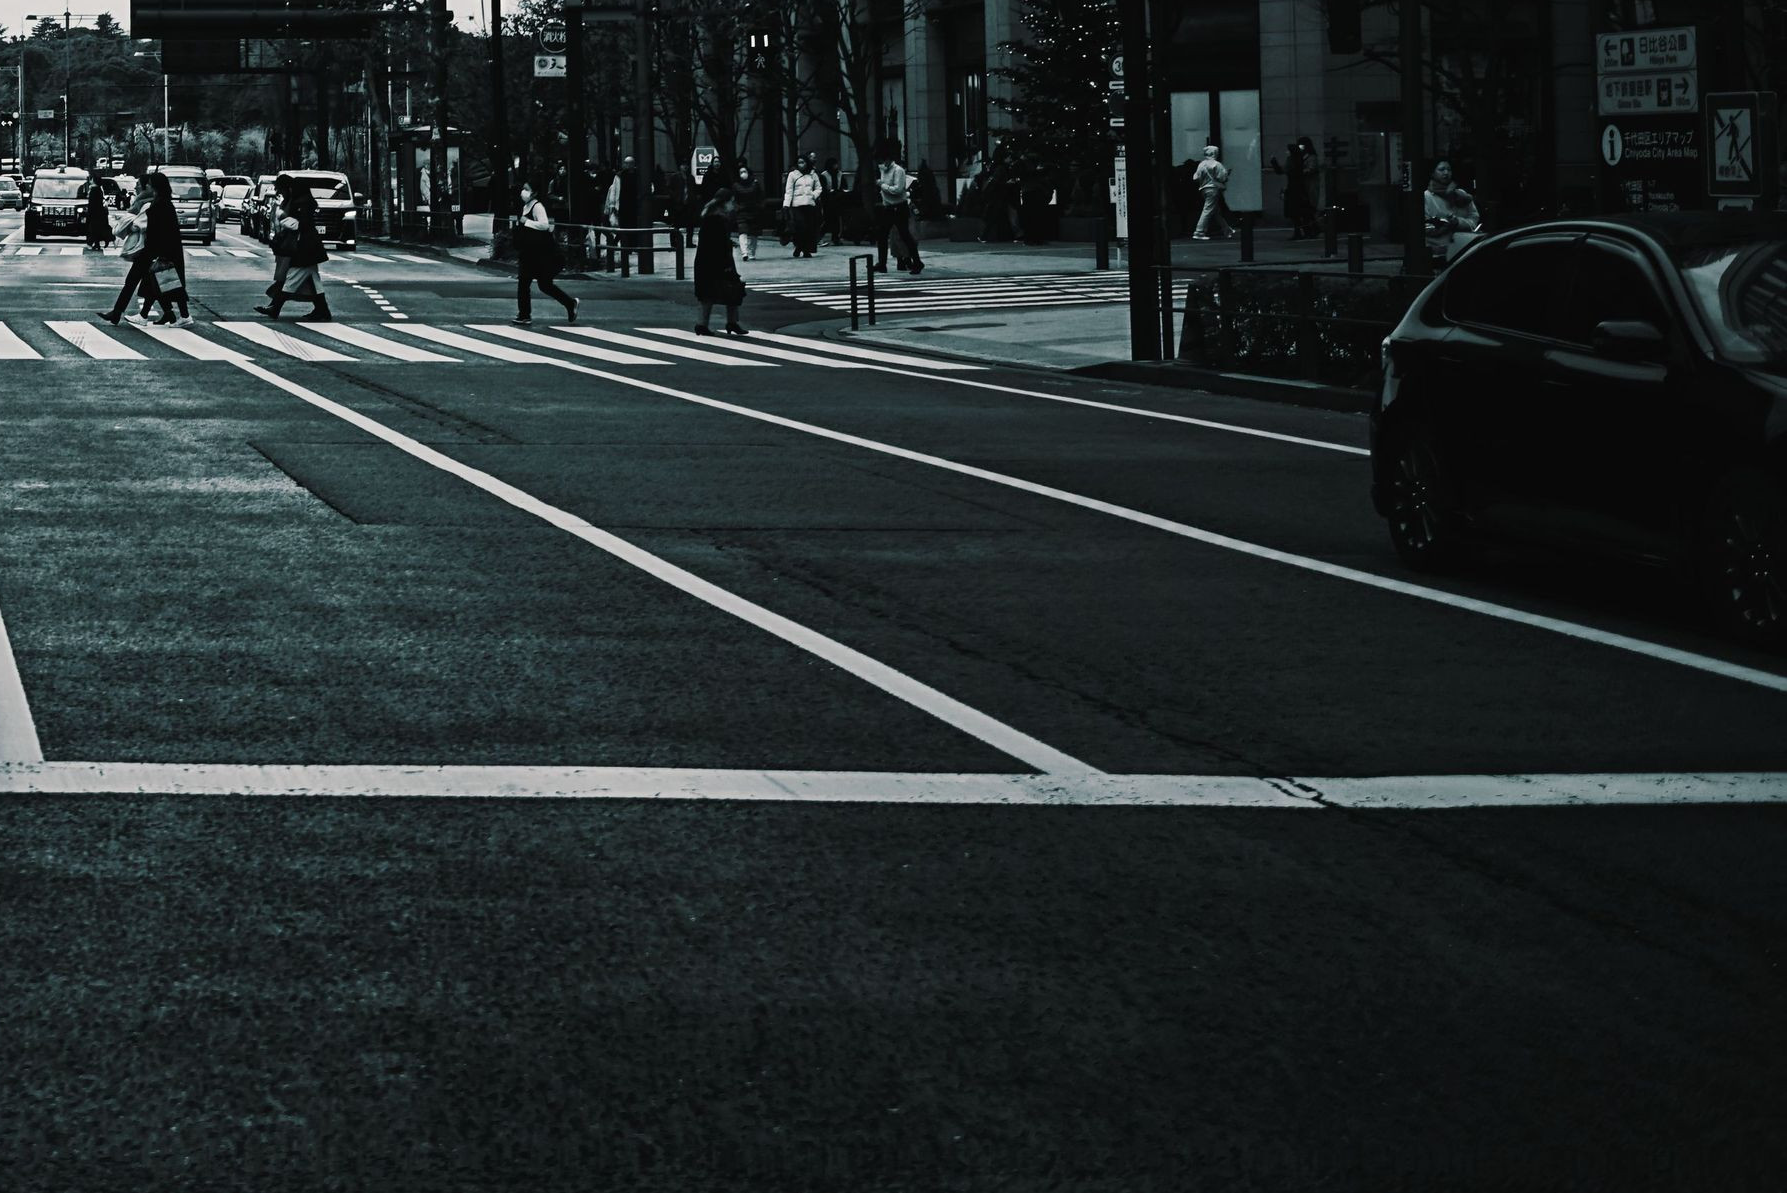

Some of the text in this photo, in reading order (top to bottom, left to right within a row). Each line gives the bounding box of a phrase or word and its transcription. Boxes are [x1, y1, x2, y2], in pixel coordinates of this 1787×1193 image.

[1639, 34, 1688, 54] 日比谷公園
[1623, 129, 1694, 145] 千代田区エリアマップ
[1624, 148, 1698, 161] Chiyoda City Area Map
